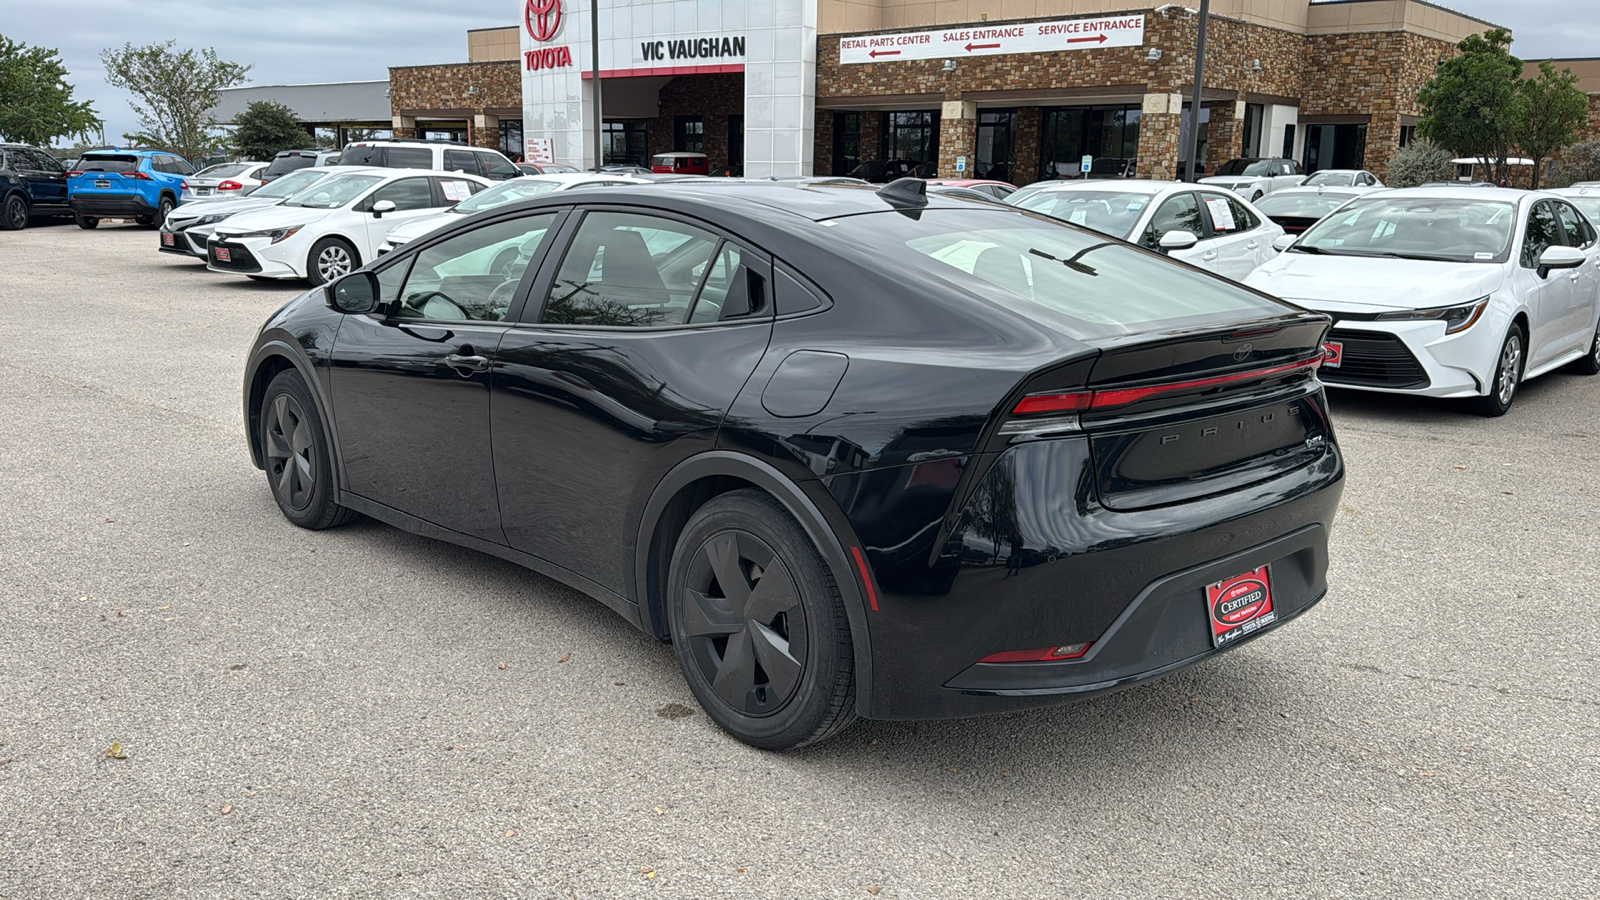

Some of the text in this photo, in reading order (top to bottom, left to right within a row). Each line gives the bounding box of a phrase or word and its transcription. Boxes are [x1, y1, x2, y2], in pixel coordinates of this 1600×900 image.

[943, 27, 1025, 42] SALES ENTRANCE
[1038, 18, 1142, 36] SERVICE ENTRANCE
[641, 37, 746, 61] VIC VAUGHAN
[841, 34, 931, 50] RETAIL PARTS CENTER
[524, 46, 572, 71] TOYOTA
[1160, 406, 1300, 445] PRIUS
